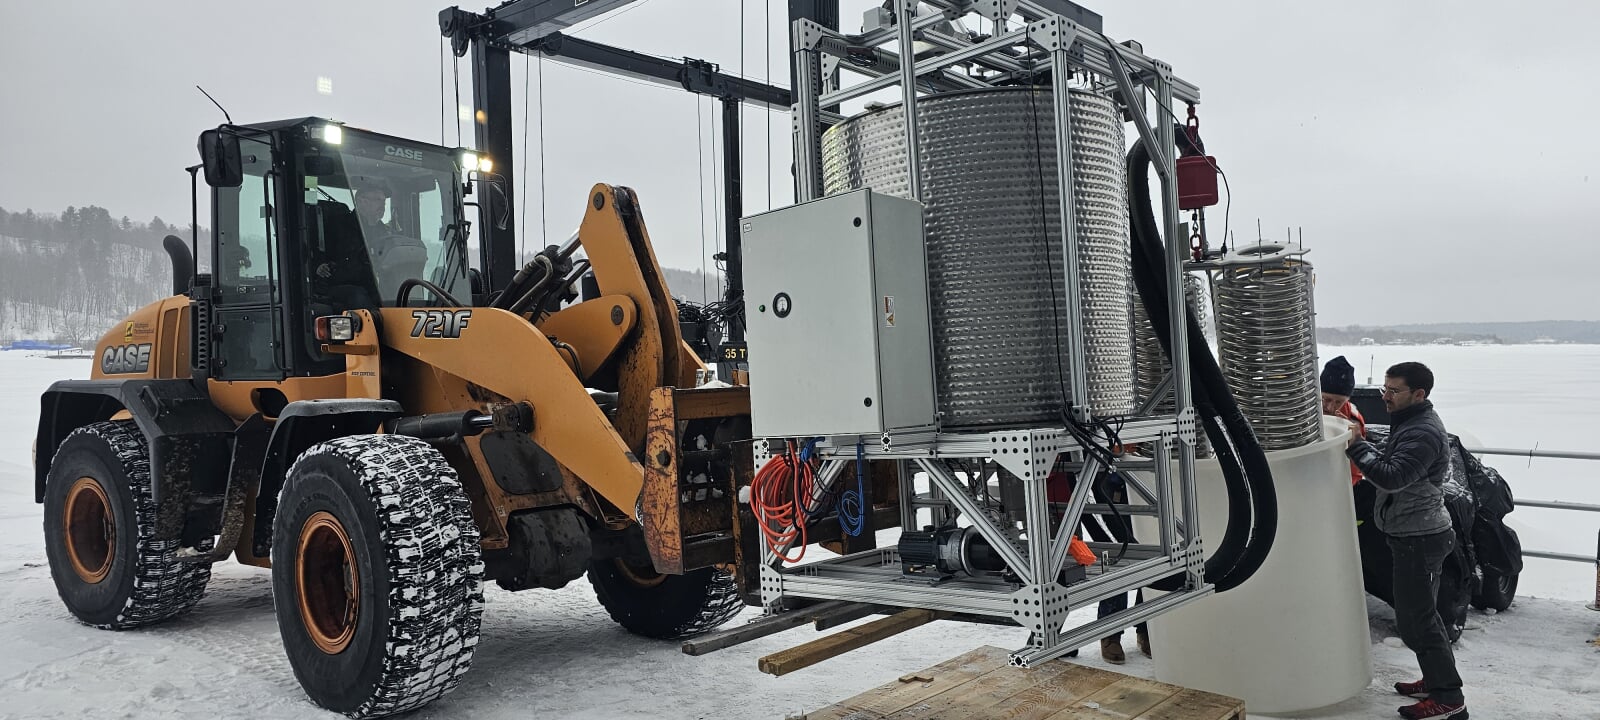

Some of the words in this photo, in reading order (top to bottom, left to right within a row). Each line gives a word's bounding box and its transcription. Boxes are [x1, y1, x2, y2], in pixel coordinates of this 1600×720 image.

[384, 145, 423, 161] CASE
[411, 310, 472, 338] 721F
[102, 343, 152, 374] CASE
[725, 348, 737, 359] 35
